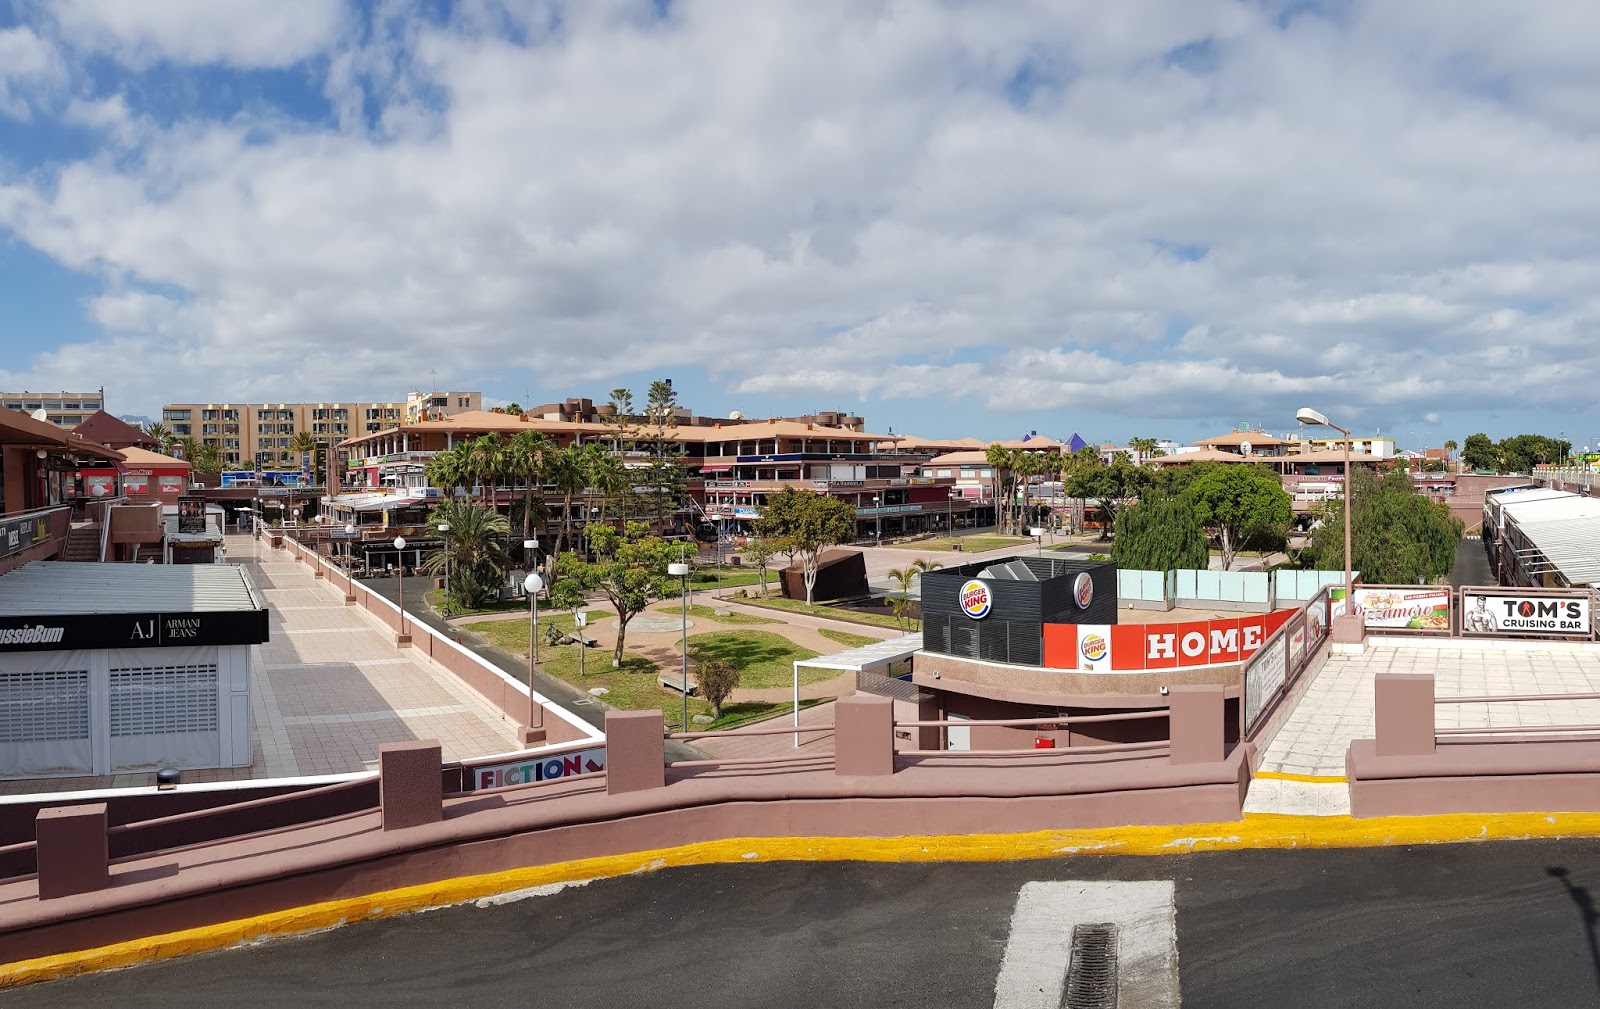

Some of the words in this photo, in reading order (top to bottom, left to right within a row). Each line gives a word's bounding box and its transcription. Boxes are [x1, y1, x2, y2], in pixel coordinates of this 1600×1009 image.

[963, 588, 986, 600] BURGER
[964, 594, 987, 609] KING
[1503, 600, 1581, 619] TOM'S
[130, 619, 155, 640] AJ
[165, 618, 201, 629] ARMANI
[1503, 619, 1556, 628] CRUISING
[1560, 620, 1581, 629] BAR
[168, 628, 197, 638] JEANS
[1083, 638, 1105, 648] BURGER
[1147, 625, 1262, 659] HOME
[1084, 643, 1106, 655] KING
[481, 755, 581, 790] FICTION
